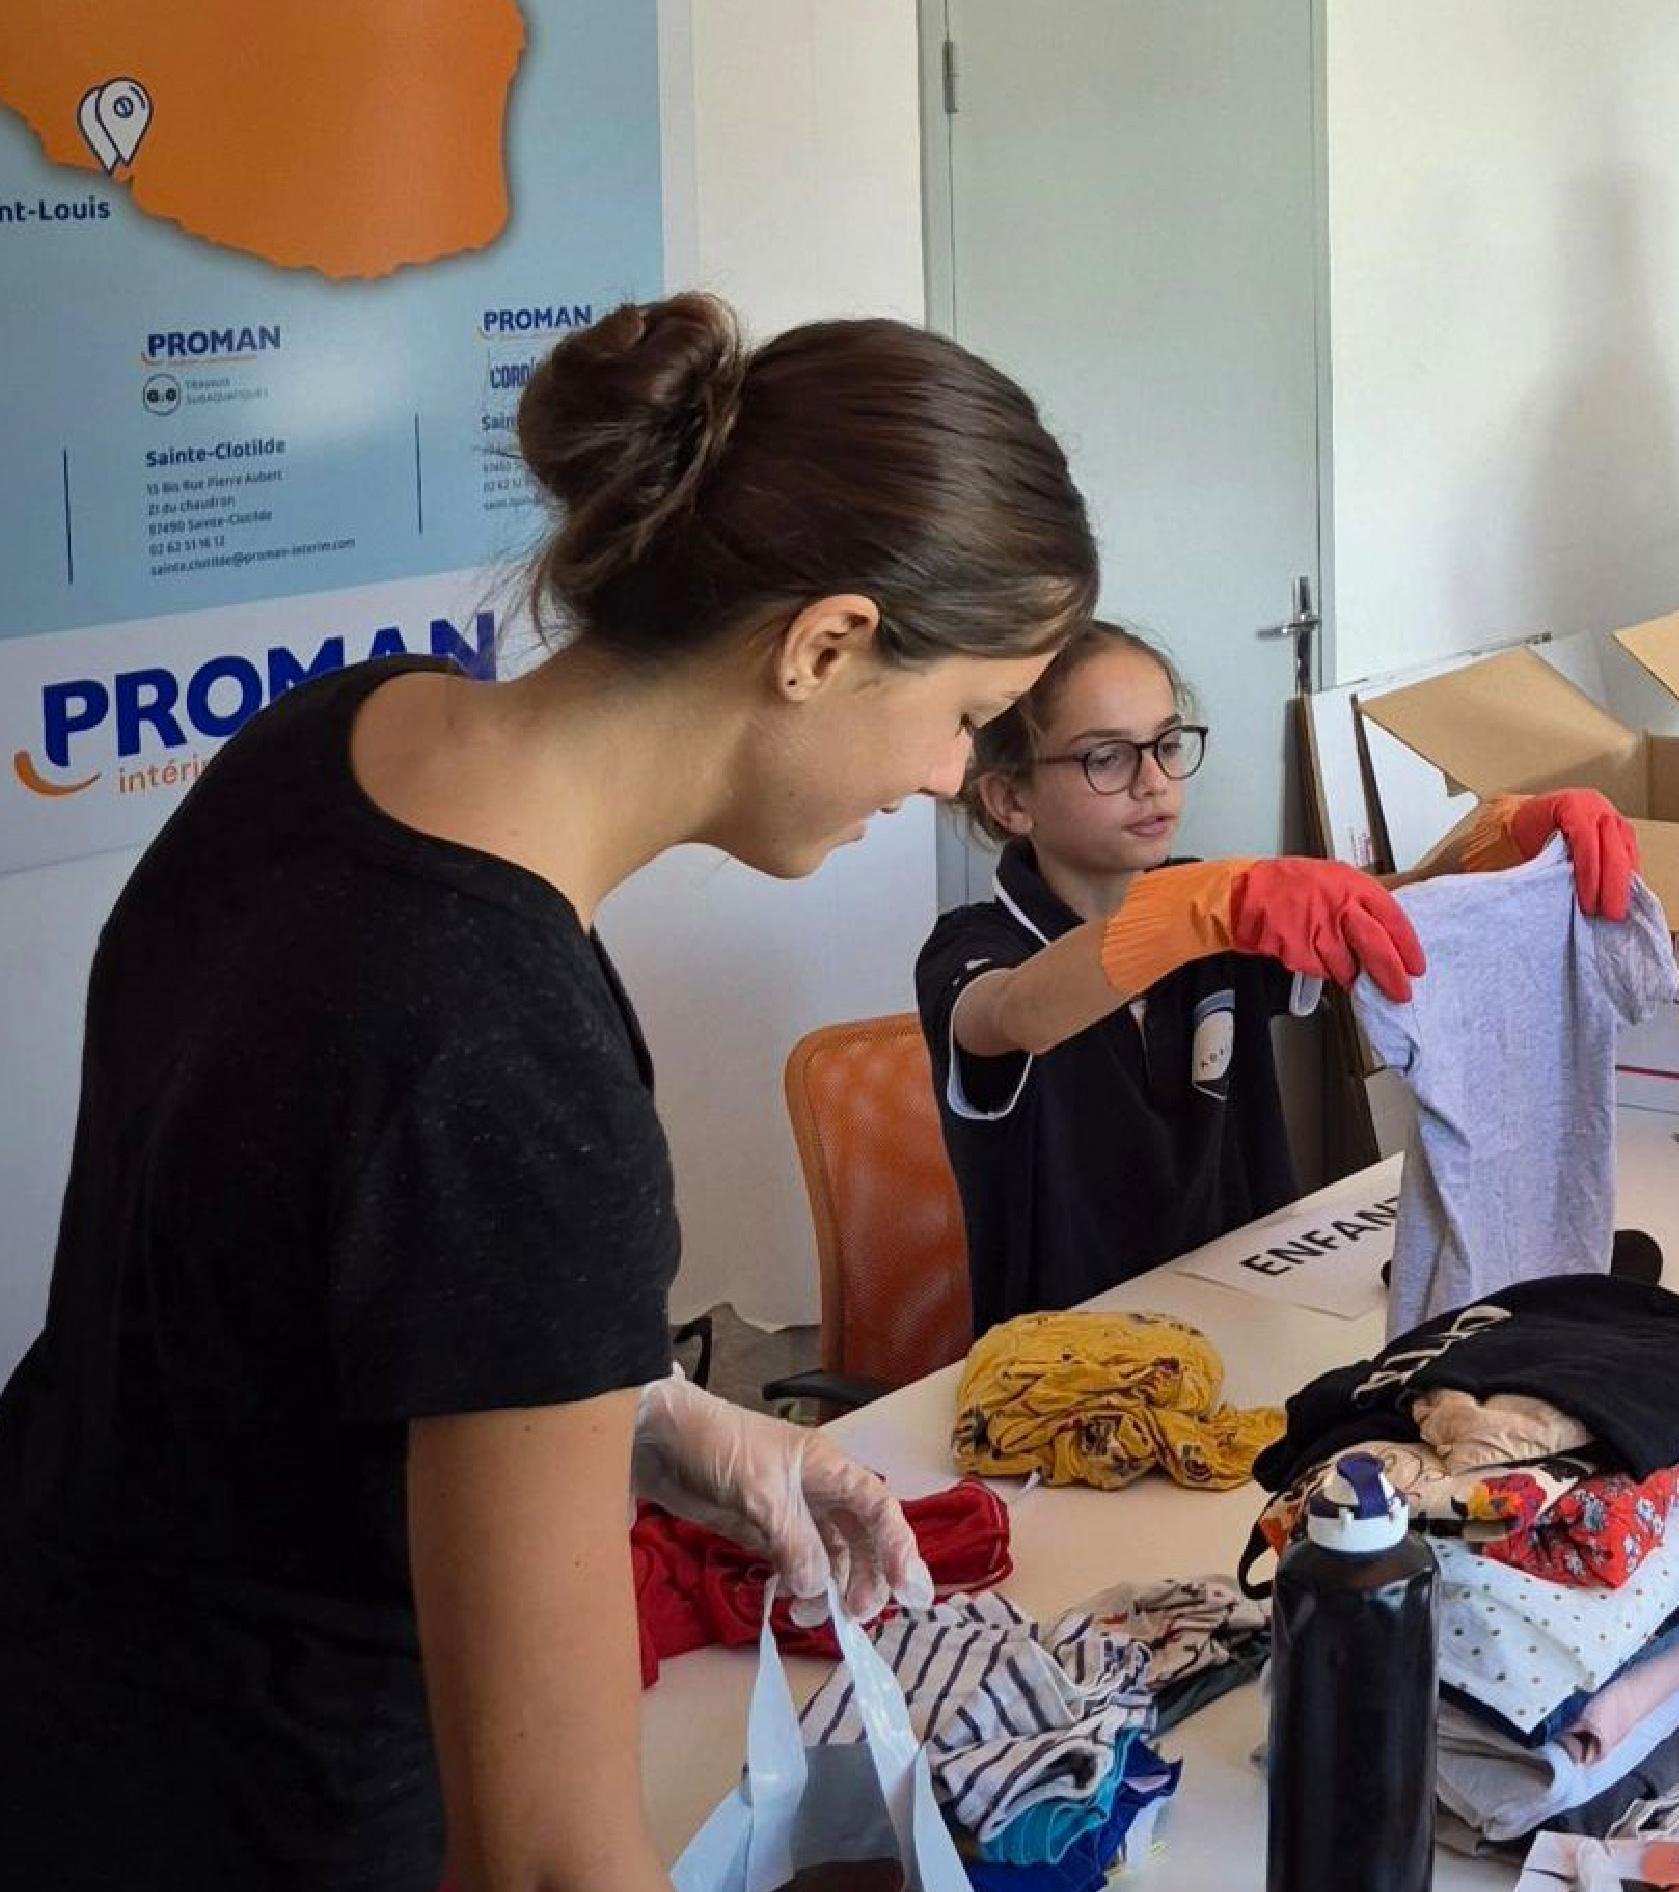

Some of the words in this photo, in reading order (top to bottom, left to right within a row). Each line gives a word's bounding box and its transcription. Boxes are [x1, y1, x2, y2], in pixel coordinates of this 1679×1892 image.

[0, 194, 111, 222] nt-Louis
[484, 304, 593, 331] PROMAN
[147, 325, 281, 357] PROMAN
[145, 437, 286, 468] Sainte-Clotilde
